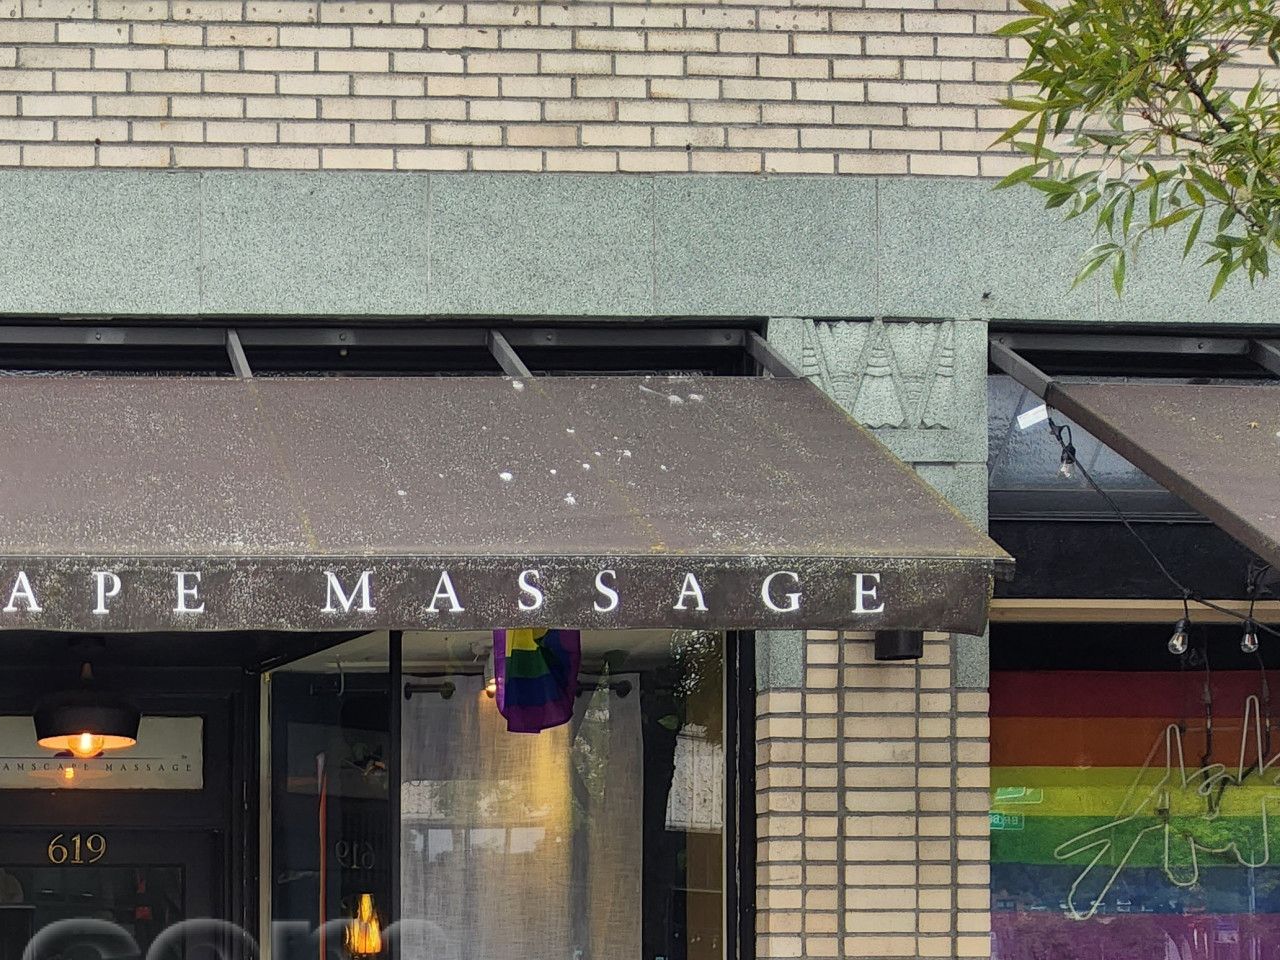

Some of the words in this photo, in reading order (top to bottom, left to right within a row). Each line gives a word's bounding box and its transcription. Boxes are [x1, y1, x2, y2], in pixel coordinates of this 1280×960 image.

[320, 570, 886, 615] MASSAGE
[105, 762, 192, 772] MASSAGE
[47, 833, 107, 864] 619
